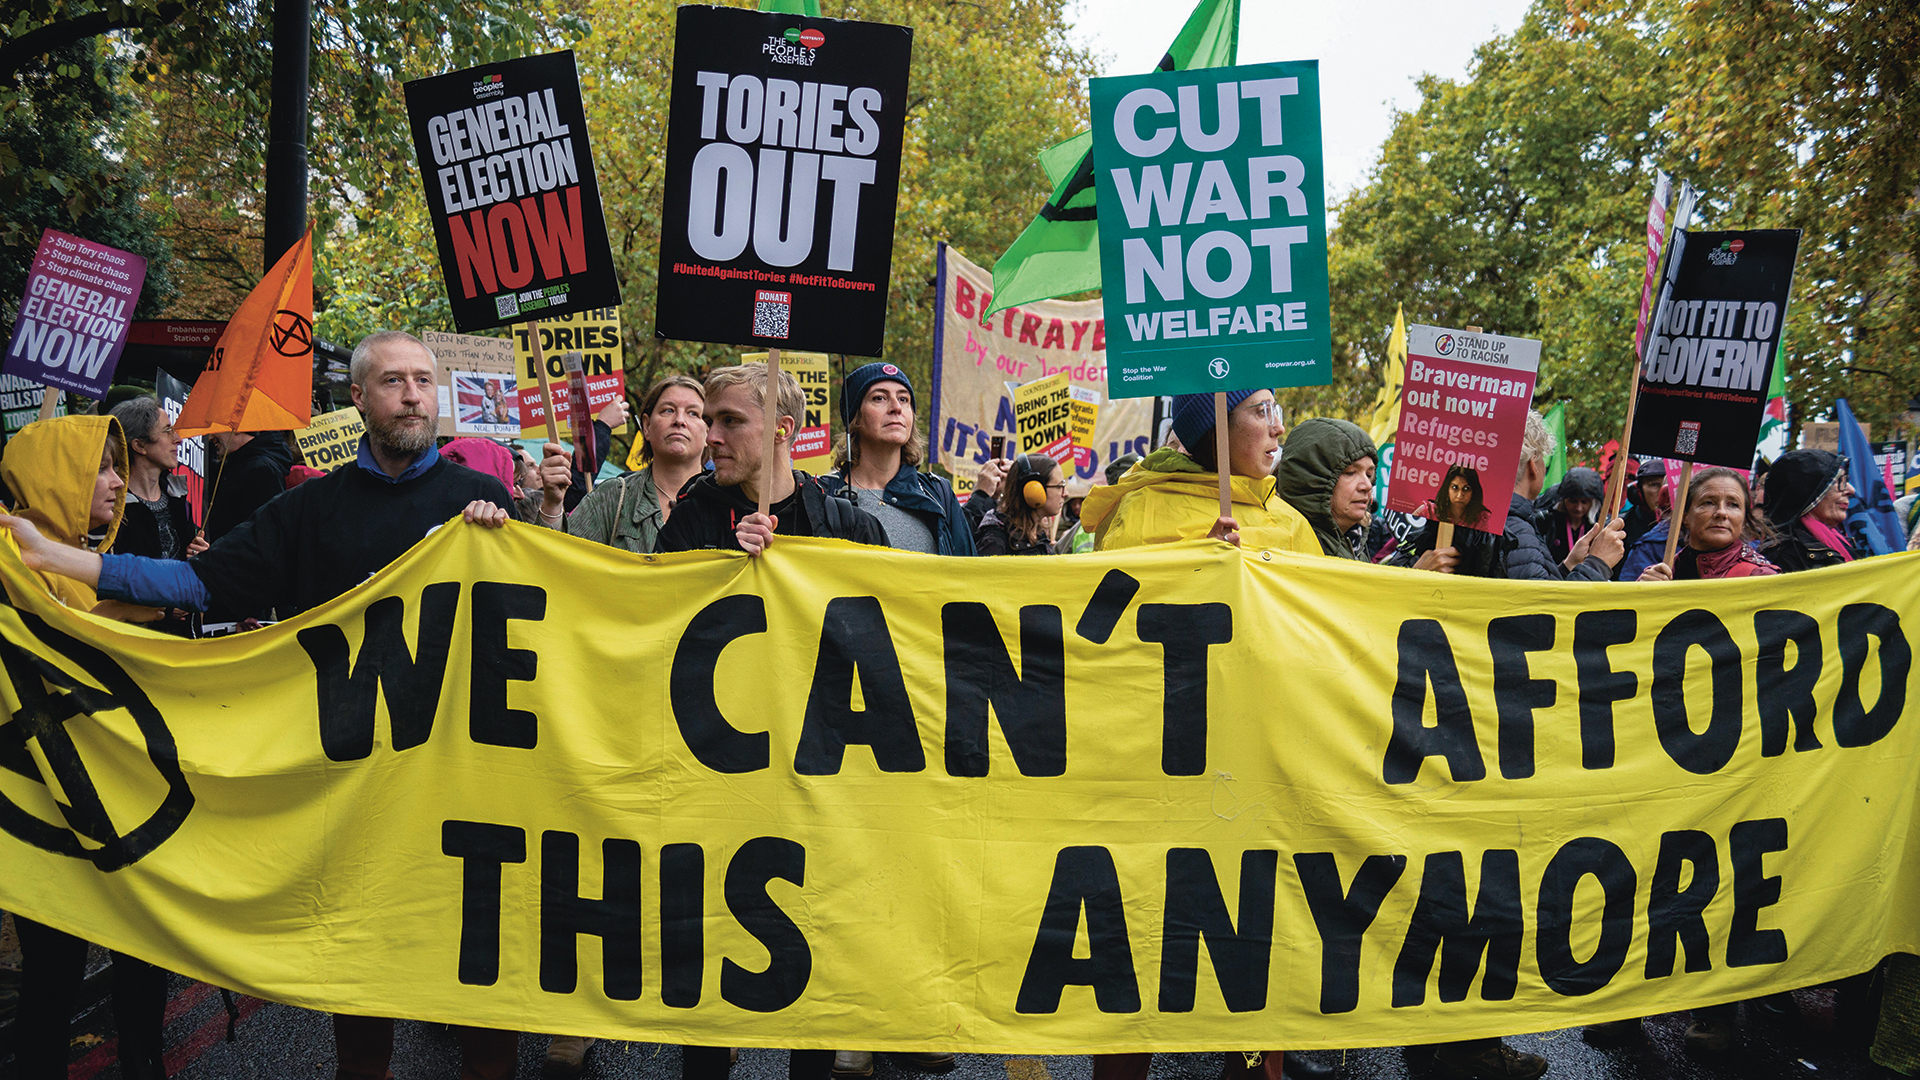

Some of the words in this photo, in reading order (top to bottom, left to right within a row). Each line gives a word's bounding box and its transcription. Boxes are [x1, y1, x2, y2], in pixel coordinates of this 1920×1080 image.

[768, 36, 787, 46] THE
[771, 54, 815, 66] ASSEMBLY
[473, 82, 504, 95] peoples
[476, 89, 504, 99] assembly
[428, 88, 569, 166] GENERAL
[696, 71, 882, 156] TORIES
[1113, 77, 1299, 157] CUT
[438, 137, 579, 214] ELECTION
[1110, 155, 1309, 229] WAR
[688, 142, 877, 272] OUT
[55, 238, 76, 251] Stop
[79, 244, 97, 258] Tory
[98, 251, 126, 266] chaos
[448, 185, 587, 299] NOW
[47, 261, 68, 275] Stop
[69, 267, 104, 286] climate
[104, 281, 133, 295] chaos
[51, 249, 72, 263] Stop
[73, 256, 102, 272] Brexit
[102, 265, 130, 281] chaos
[673, 262, 786, 283] #UnitedAgainstTories
[789, 273, 876, 292] #NotFitToGovern
[1123, 226, 1308, 304] NOT
[31, 275, 126, 323] GENERAL
[519, 291, 533, 303] JOIN
[532, 288, 544, 300] THE
[543, 283, 570, 297] PEOPLE'S
[520, 297, 549, 313] ASSEMBLY
[548, 293, 568, 306] TODAY
[759, 292, 788, 303] DONATE
[23, 296, 125, 342] ELECTION
[167, 325, 217, 334] Embankment
[1124, 302, 1308, 341] WELFARE
[1658, 300, 1702, 336] NOT
[1701, 301, 1744, 338] FIT
[1742, 302, 1777, 341] TO
[12, 319, 114, 380] NOW
[173, 334, 201, 342] Station
[426, 333, 453, 343] EVEN
[474, 338, 494, 347] GOT
[515, 326, 619, 352] TORIES
[1457, 336, 1490, 350] STAND
[1491, 341, 1506, 352] UP
[432, 348, 457, 358] VOTES
[460, 349, 479, 359] THAN
[964, 330, 989, 366] by
[996, 354, 1029, 378] our
[1265, 359, 1316, 369] stopwar.org.uk
[1457, 347, 1469, 359] TO
[1470, 349, 1510, 365] RACISM
[1646, 337, 1771, 391] GOVERN
[797, 371, 828, 383] THE
[1122, 367, 1139, 375] Stop
[1122, 374, 1154, 382] Coalition
[1410, 360, 1528, 398] Braverman
[1, 391, 32, 410] BILLS
[1016, 395, 1048, 415] BRING
[1050, 387, 1070, 403] THE
[1407, 389, 1441, 410] out
[1445, 397, 1497, 419] now!
[1704, 391, 1758, 404] #NotFitToGovern
[305, 412, 350, 431] COUNTERFIRE
[474, 424, 490, 432] NUL
[1018, 401, 1070, 434] TORIES
[1403, 412, 1499, 448] Refugees
[1681, 421, 1699, 430] DONATE
[298, 428, 339, 449] BRING
[340, 421, 365, 438] THE
[796, 441, 824, 453] RESIST
[943, 417, 991, 465] IT'S
[1023, 421, 1067, 452] DOWN
[304, 439, 359, 468] TORIE
[1400, 441, 1490, 472] welcome
[1395, 460, 1441, 487] here
[297, 581, 548, 762] WE
[670, 568, 1234, 778] CAN'T
[1382, 602, 1913, 785] AFFORD
[441, 820, 813, 1013] THIS
[1015, 817, 1789, 1014] ANYMORE
